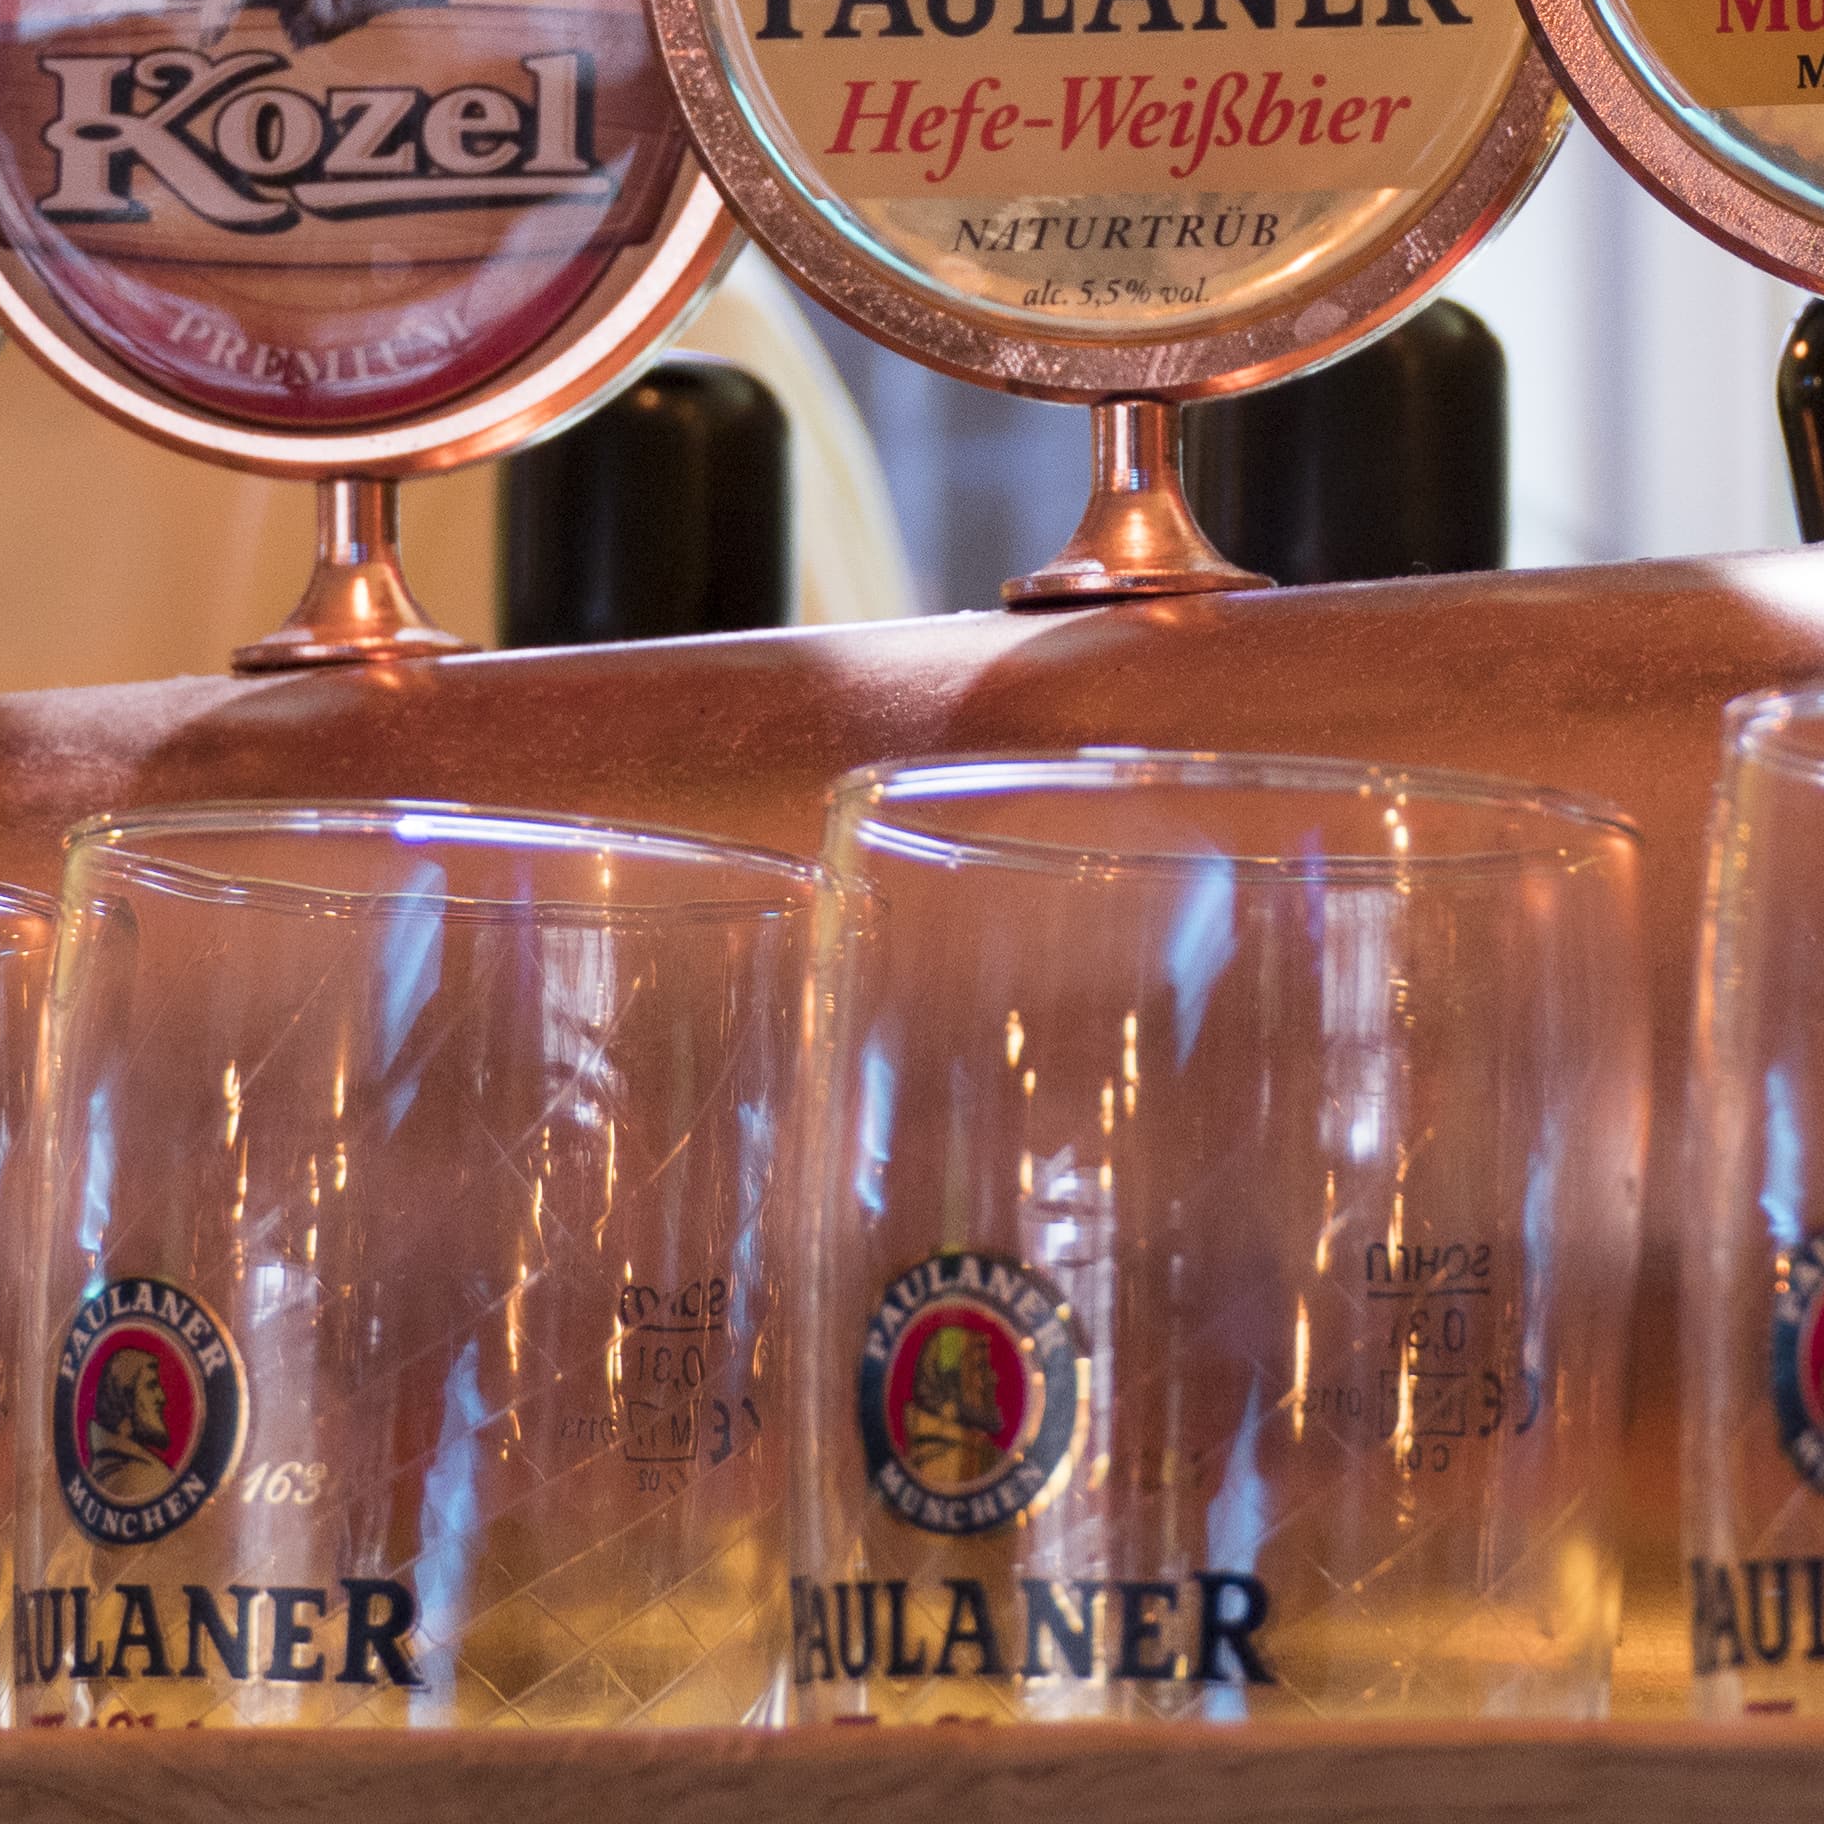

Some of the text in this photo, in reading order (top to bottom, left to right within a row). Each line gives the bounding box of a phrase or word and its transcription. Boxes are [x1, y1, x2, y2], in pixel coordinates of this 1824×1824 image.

[40, 48, 606, 234] Kozel
[824, 72, 1412, 183] Hefe-Weißbier
[952, 211, 1279, 254] NATURTRÜB
[1023, 275, 1212, 311] alc. 5,5% vol.
[61, 1281, 226, 1381] PAULANER
